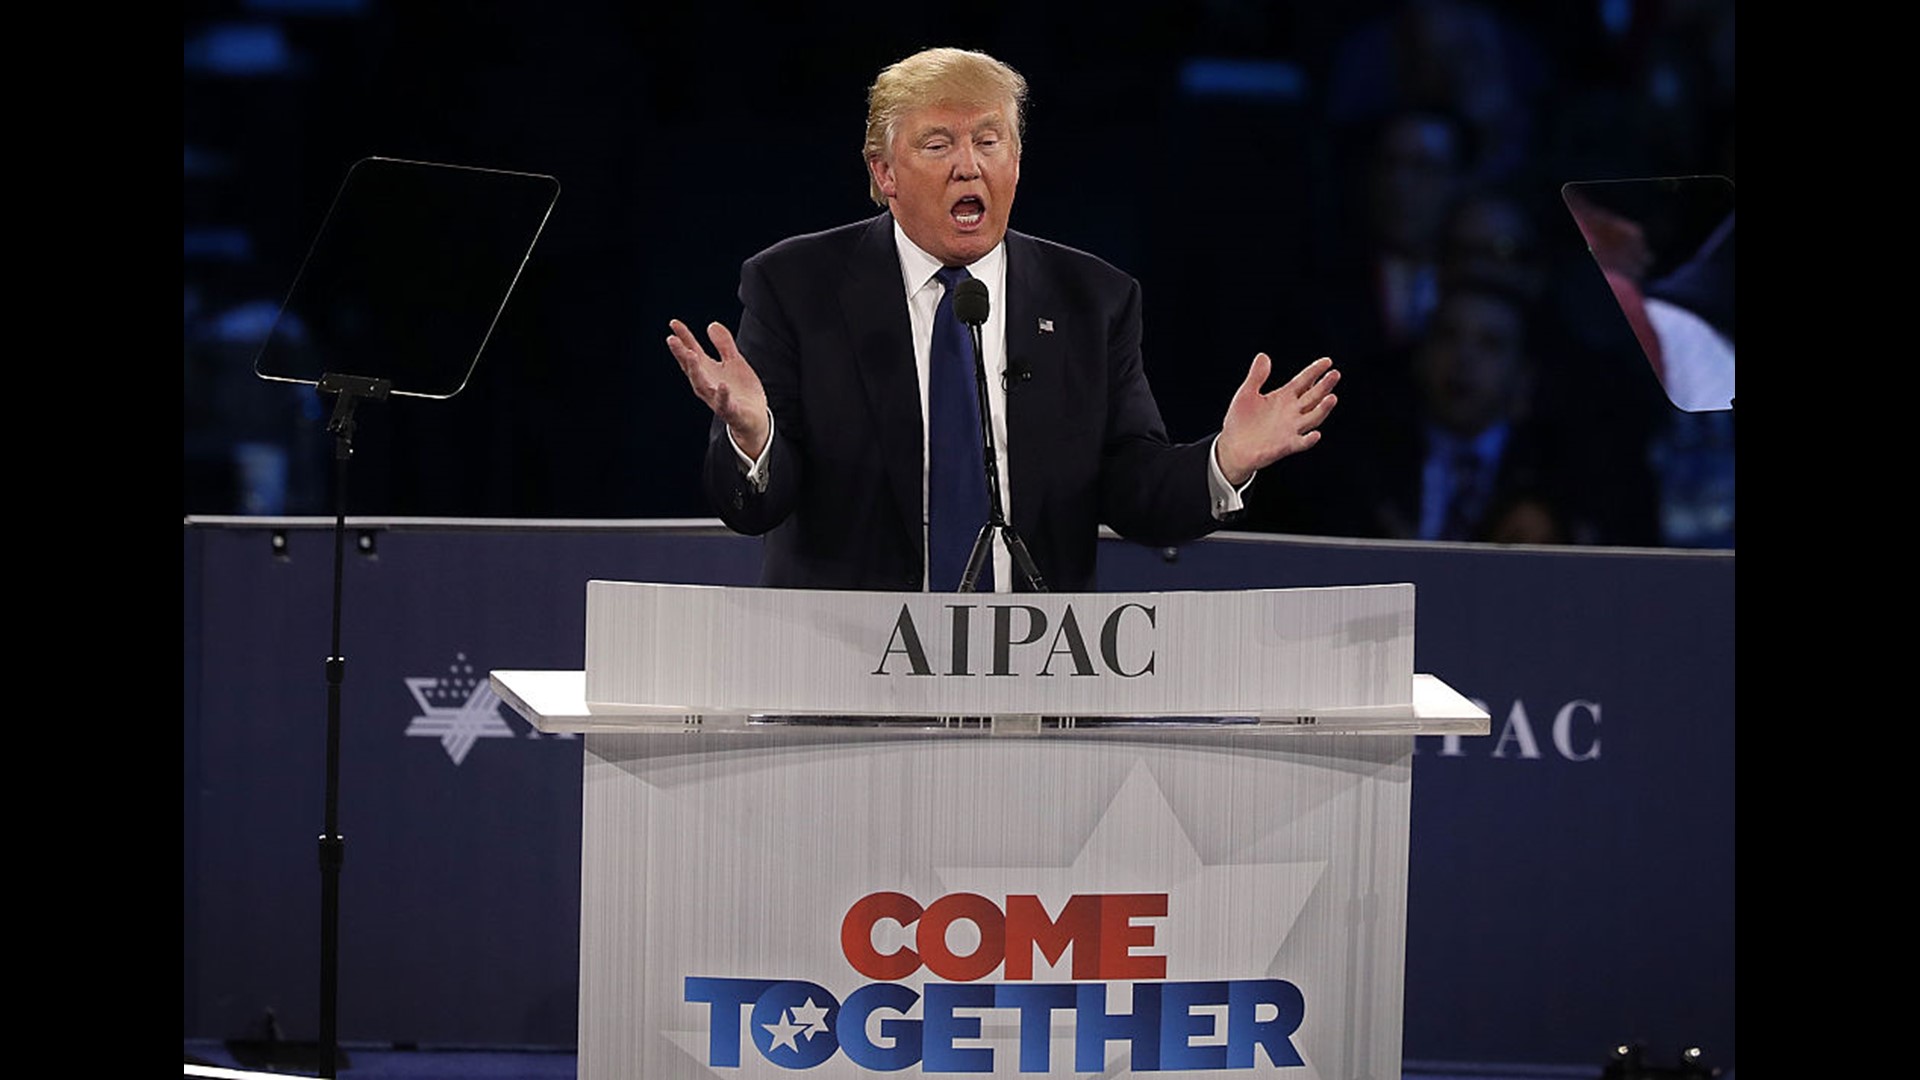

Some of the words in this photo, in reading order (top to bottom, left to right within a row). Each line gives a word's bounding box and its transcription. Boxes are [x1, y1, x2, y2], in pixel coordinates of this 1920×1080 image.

[871, 603, 1156, 678] AIPAC
[1414, 698, 1601, 761] AC
[841, 891, 1168, 981] COME
[684, 976, 1305, 1072] TOGETHER
